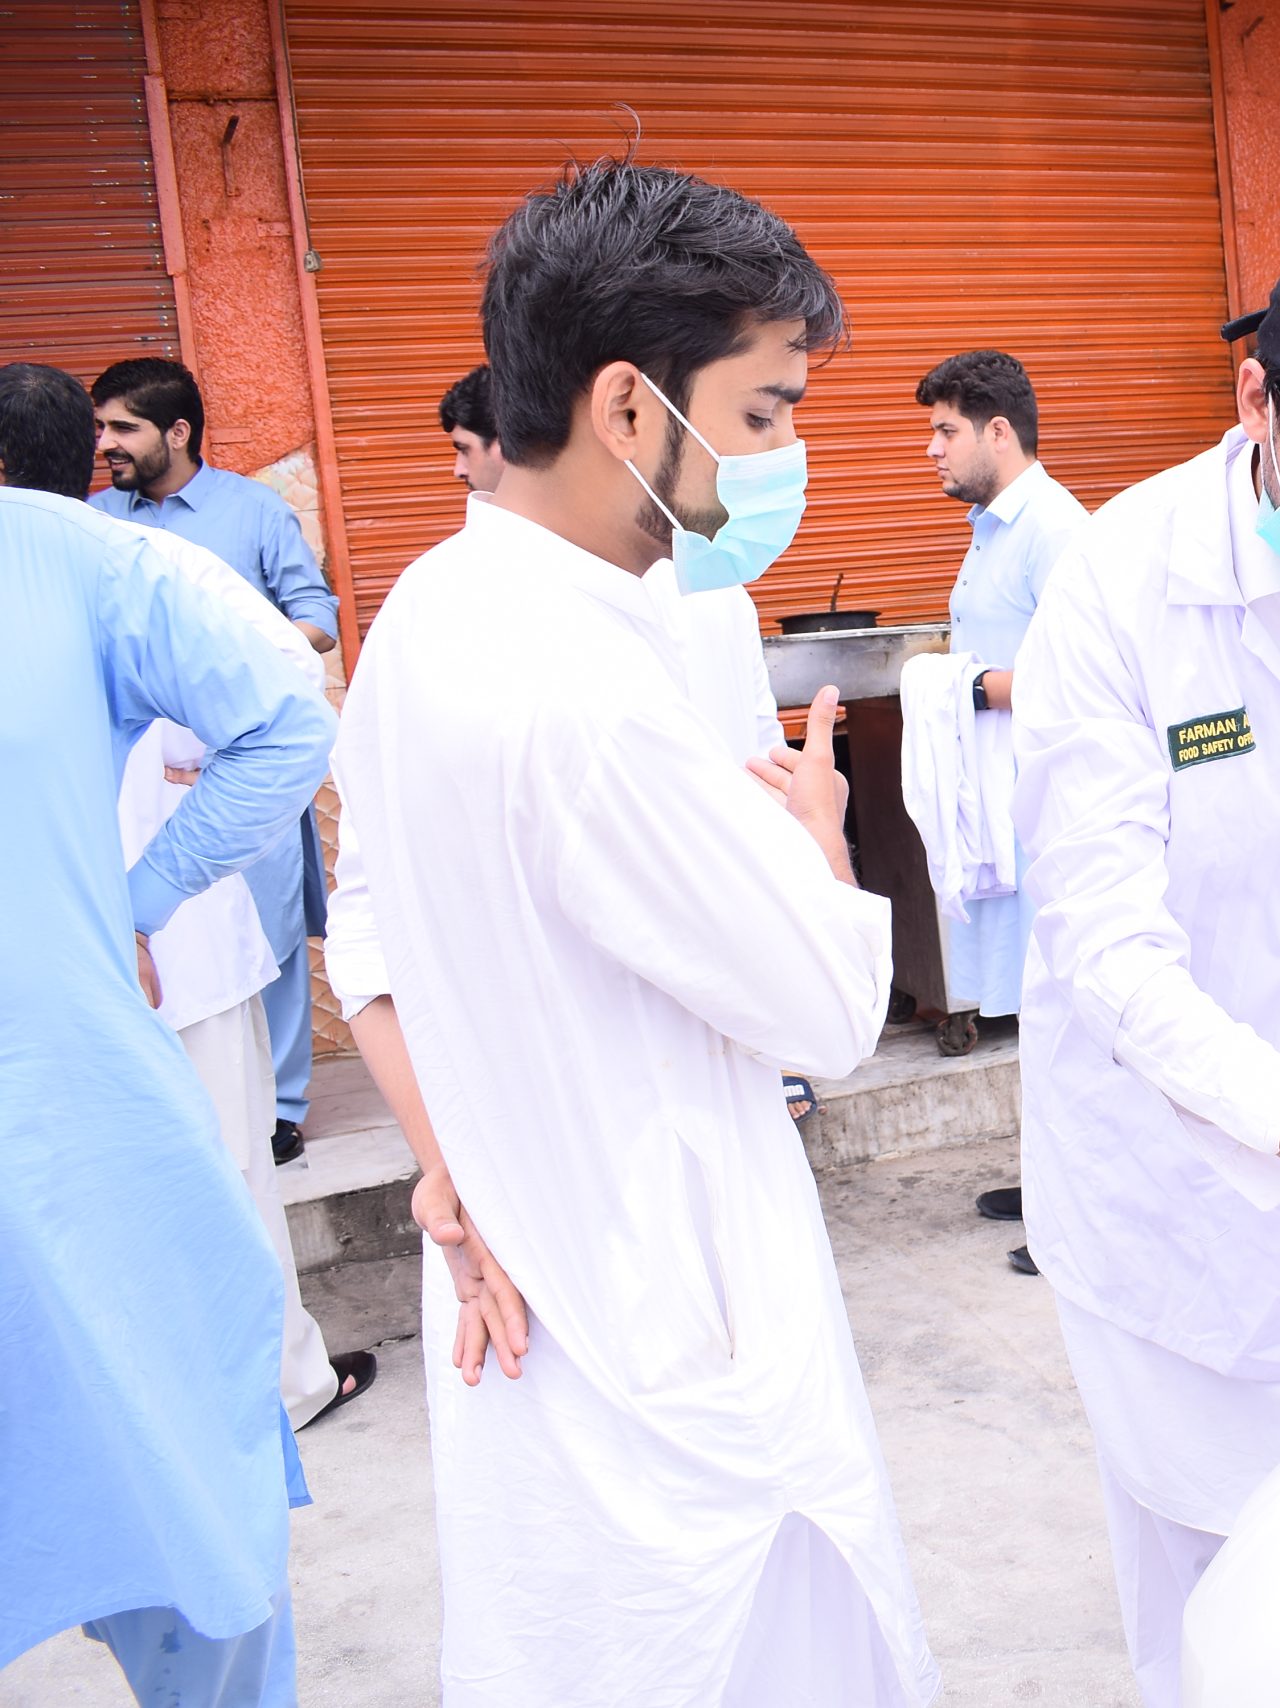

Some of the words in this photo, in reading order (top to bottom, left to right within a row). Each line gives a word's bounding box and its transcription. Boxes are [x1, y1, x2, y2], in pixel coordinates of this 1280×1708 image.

[1179, 717, 1238, 744] FARMAN
[1178, 745, 1200, 762] FOOD
[1201, 738, 1235, 755] SAFETY
